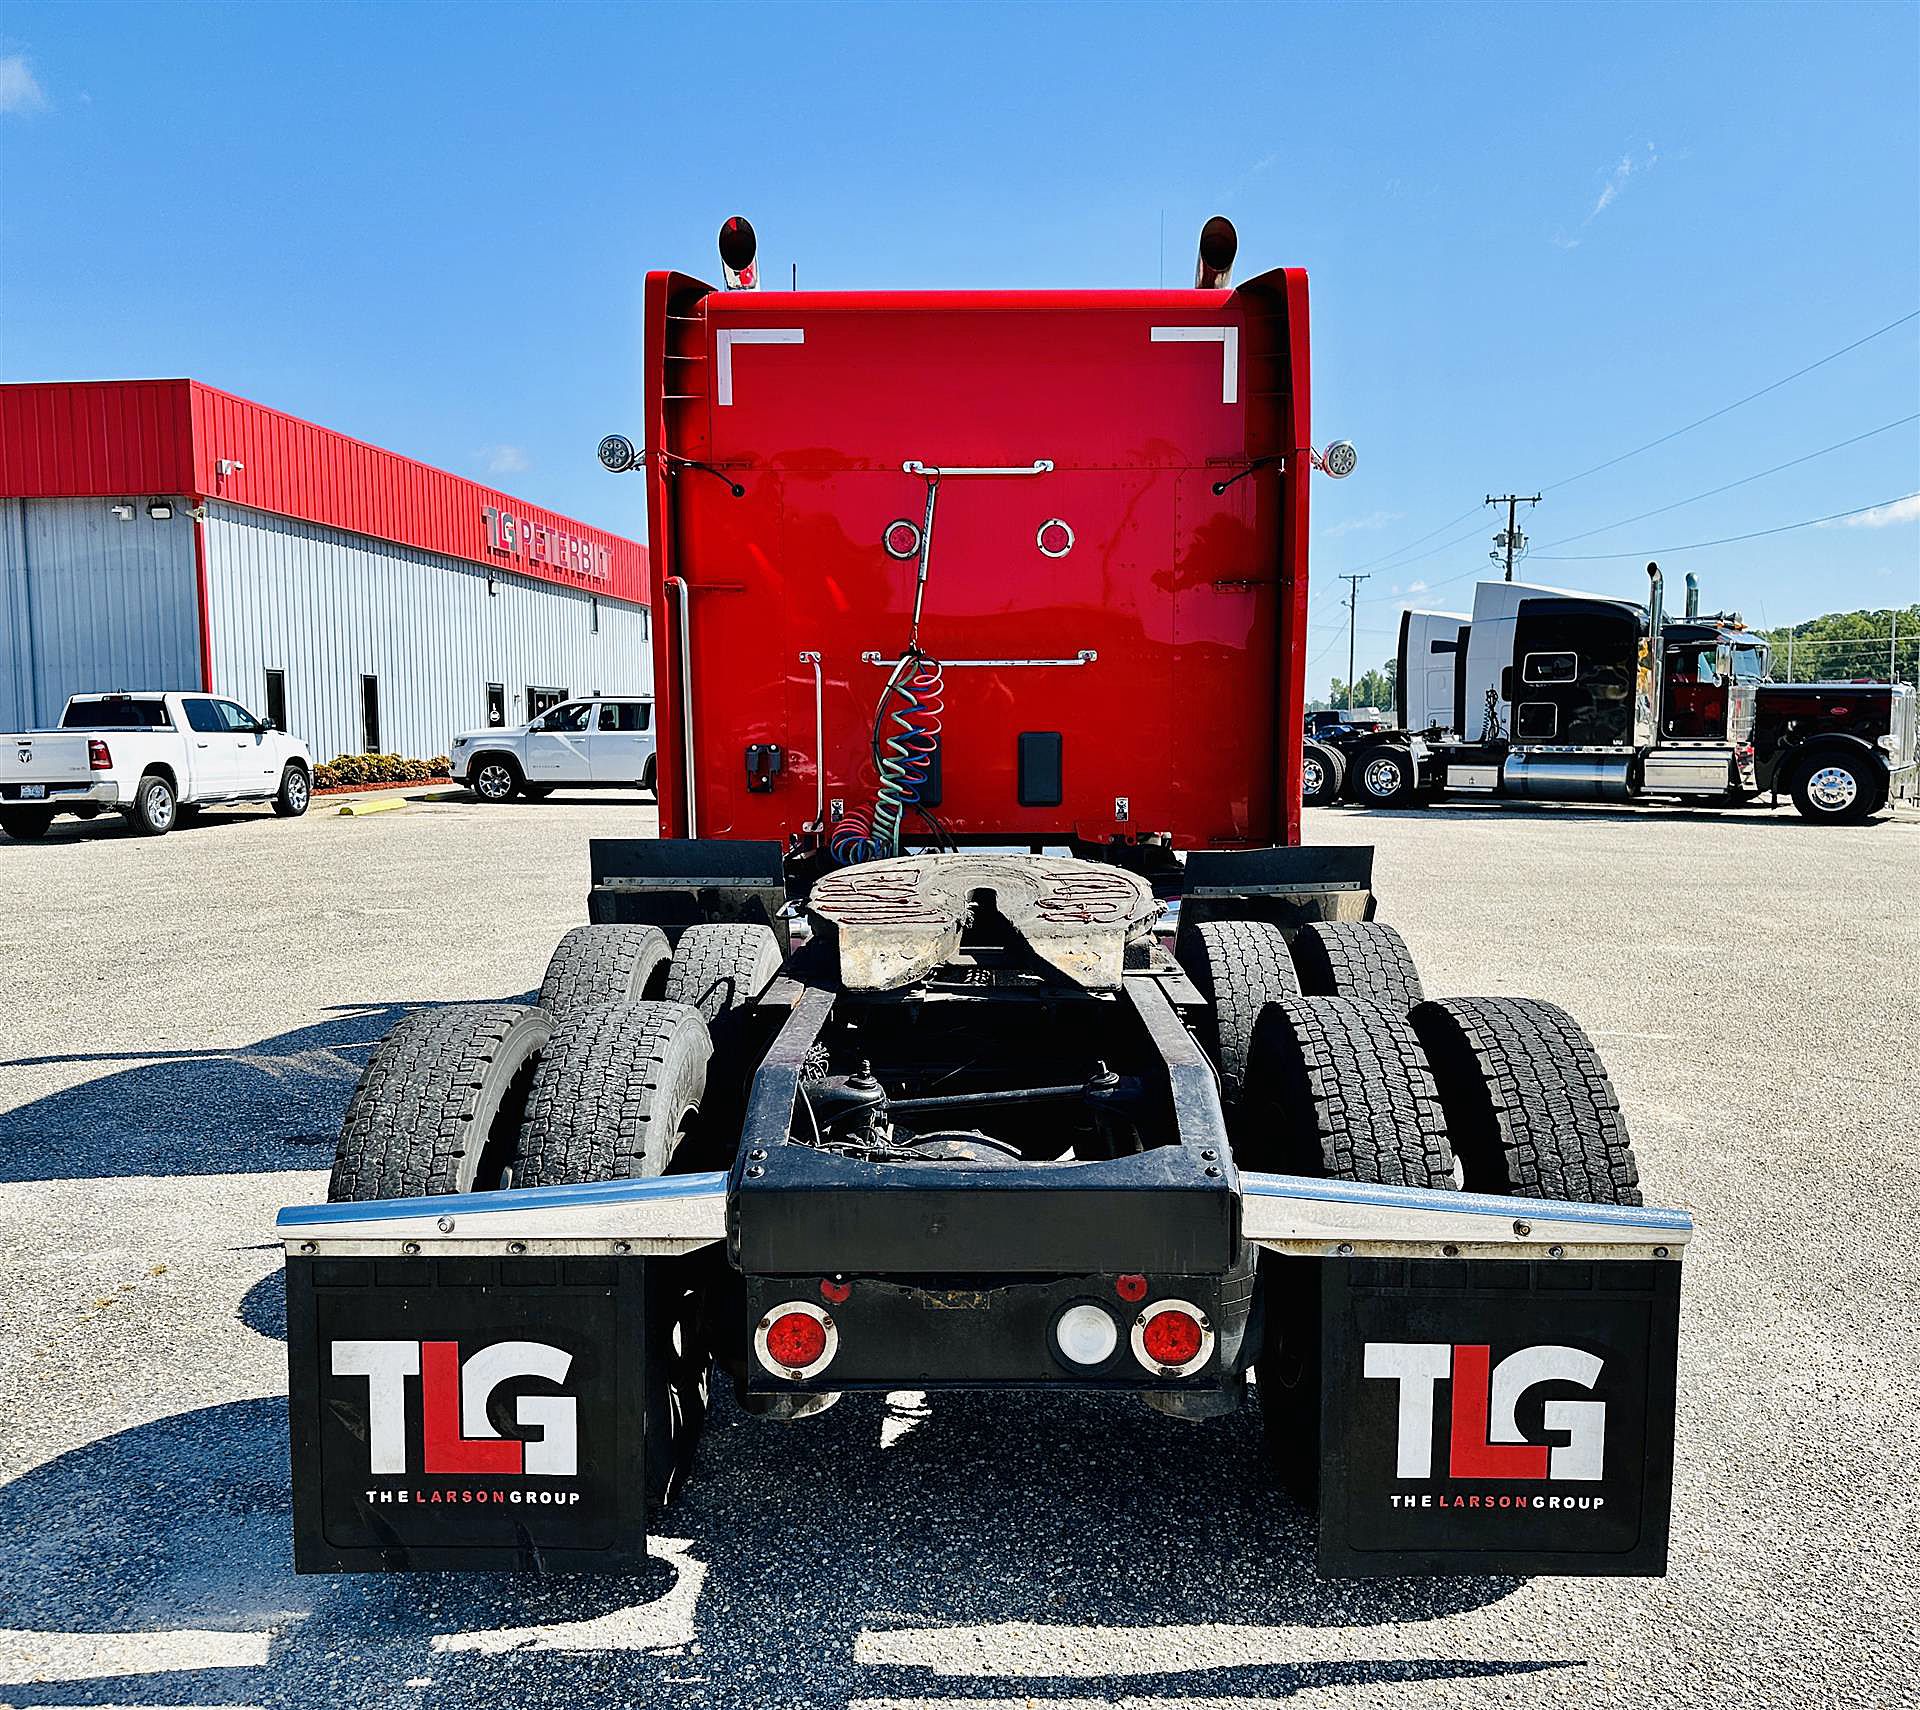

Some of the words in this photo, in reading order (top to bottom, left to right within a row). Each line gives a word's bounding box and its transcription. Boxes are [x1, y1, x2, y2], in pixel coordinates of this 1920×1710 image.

[482, 506, 517, 552] TLG
[518, 518, 613, 578] PETERBILT
[331, 1340, 578, 1476] TLG
[1363, 1342, 1607, 1481] TLG
[367, 1491, 409, 1503] THE
[1391, 1495, 1432, 1507] THE
